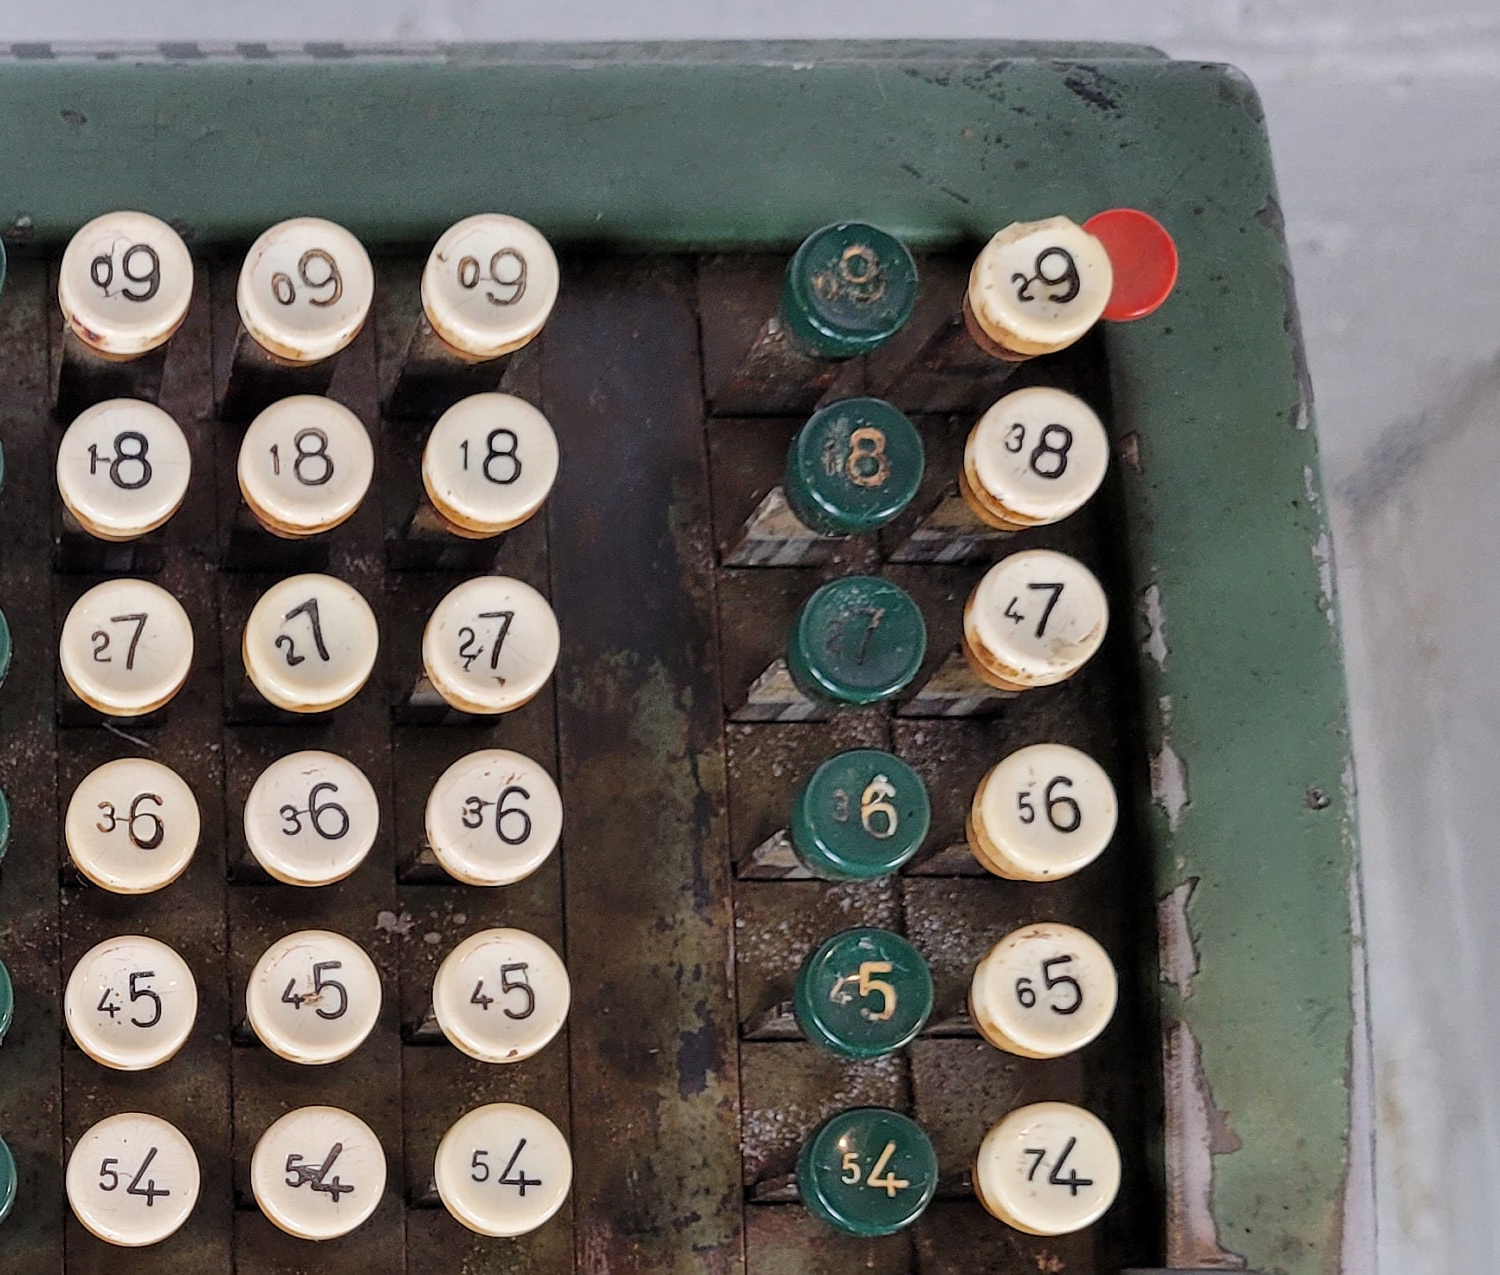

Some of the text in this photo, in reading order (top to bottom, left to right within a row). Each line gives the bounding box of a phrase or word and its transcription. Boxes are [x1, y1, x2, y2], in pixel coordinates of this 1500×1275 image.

[269, 427, 335, 486] 18
[459, 428, 523, 485] 18
[1005, 423, 1073, 480] 38
[1004, 582, 1065, 639] 47
[92, 613, 149, 671] 27
[1017, 775, 1082, 834] 56
[96, 970, 163, 1029] 45
[281, 960, 348, 1020] 45
[469, 962, 536, 1020] 45
[1014, 955, 1084, 1016] 65
[98, 1146, 171, 1207] 54
[470, 1138, 542, 1198] 54
[841, 1140, 910, 1198] 54
[1023, 1136, 1094, 1197] 74
